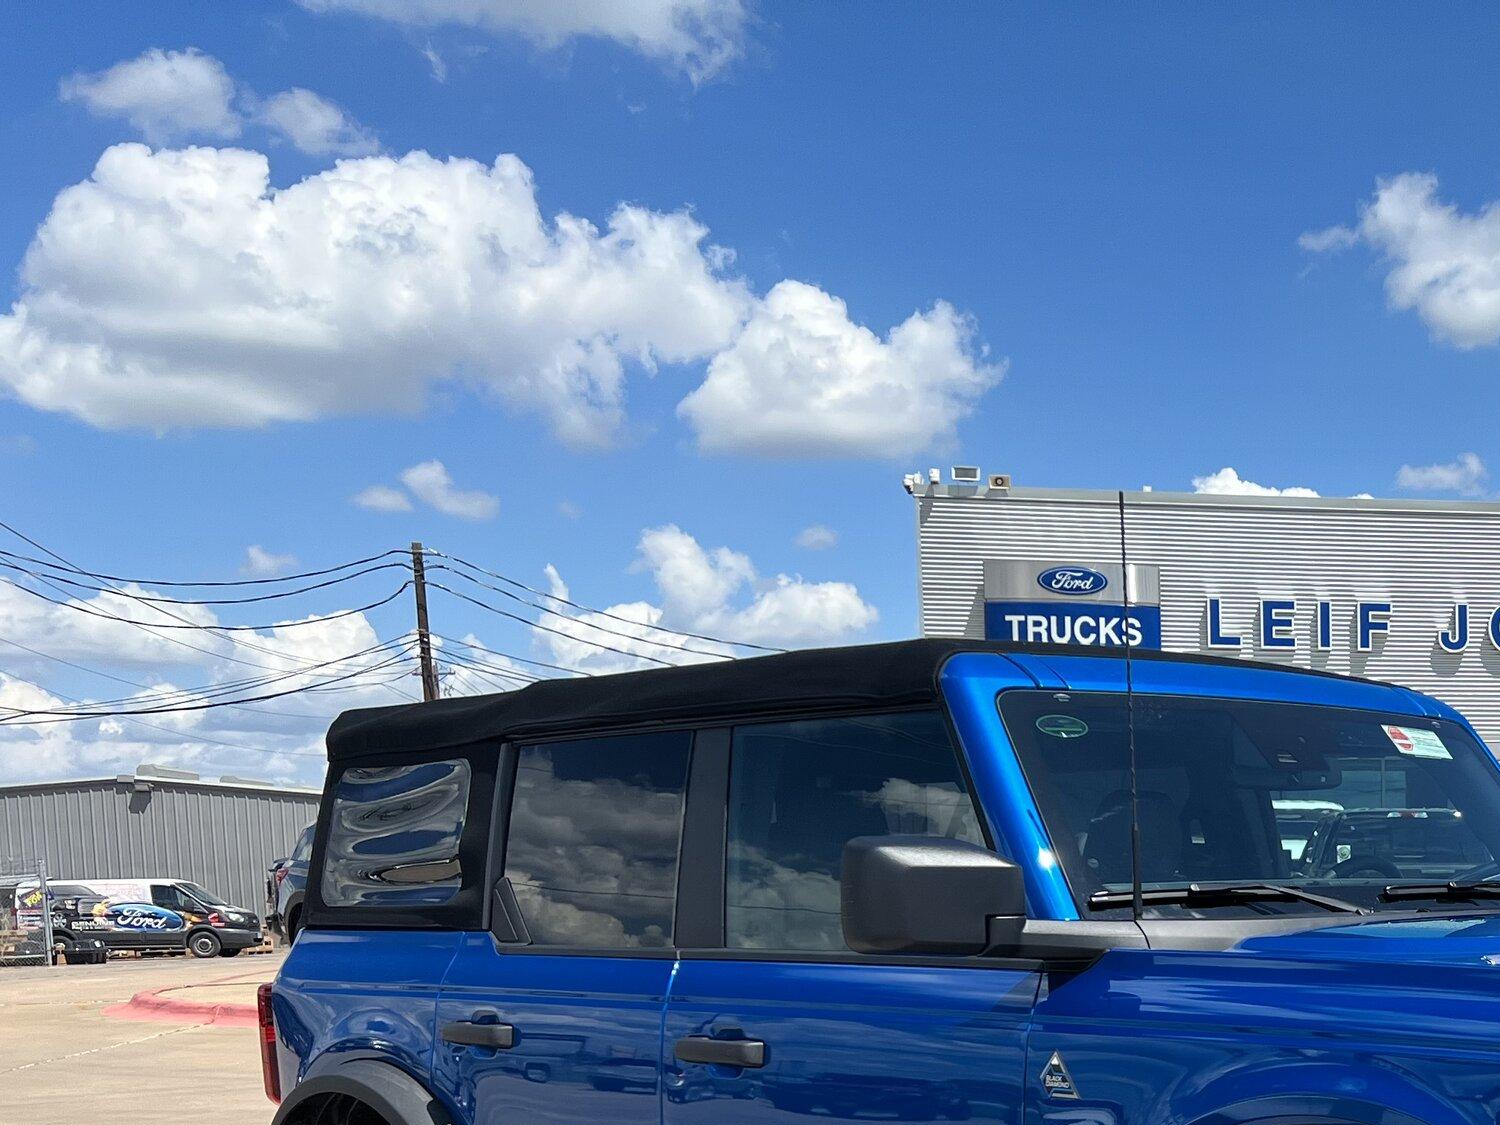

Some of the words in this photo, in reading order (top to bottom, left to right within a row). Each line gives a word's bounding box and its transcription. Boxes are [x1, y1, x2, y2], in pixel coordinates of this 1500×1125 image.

[1051, 570, 1094, 590] Ford
[1004, 614, 1143, 647] TRUCKS
[1206, 598, 1393, 651] LEIF
[117, 909, 167, 929] Ford
